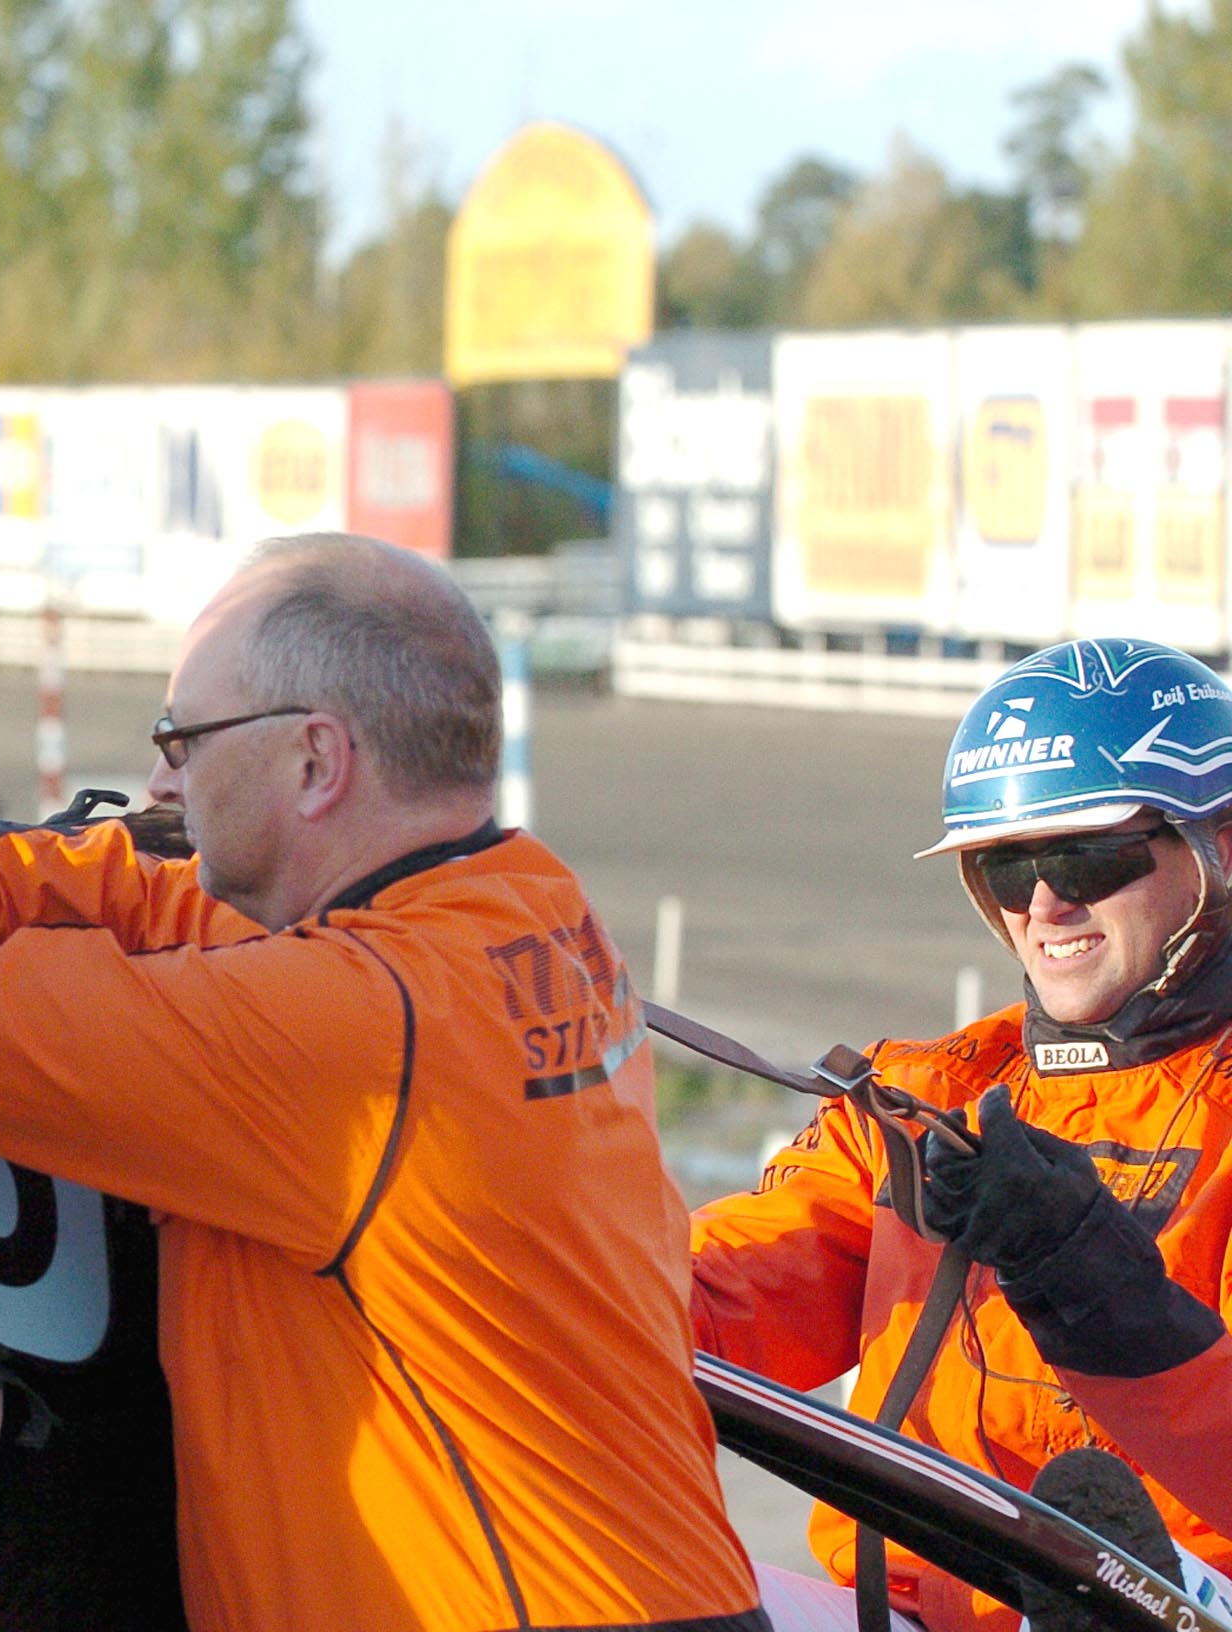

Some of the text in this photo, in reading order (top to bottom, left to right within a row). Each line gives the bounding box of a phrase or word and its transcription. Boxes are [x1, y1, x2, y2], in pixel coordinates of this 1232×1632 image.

[1151, 685, 1186, 711] Leif
[951, 734, 1074, 777] TWINNER
[1041, 1045, 1104, 1067] BEOLA
[1095, 1551, 1171, 1620] Michael
